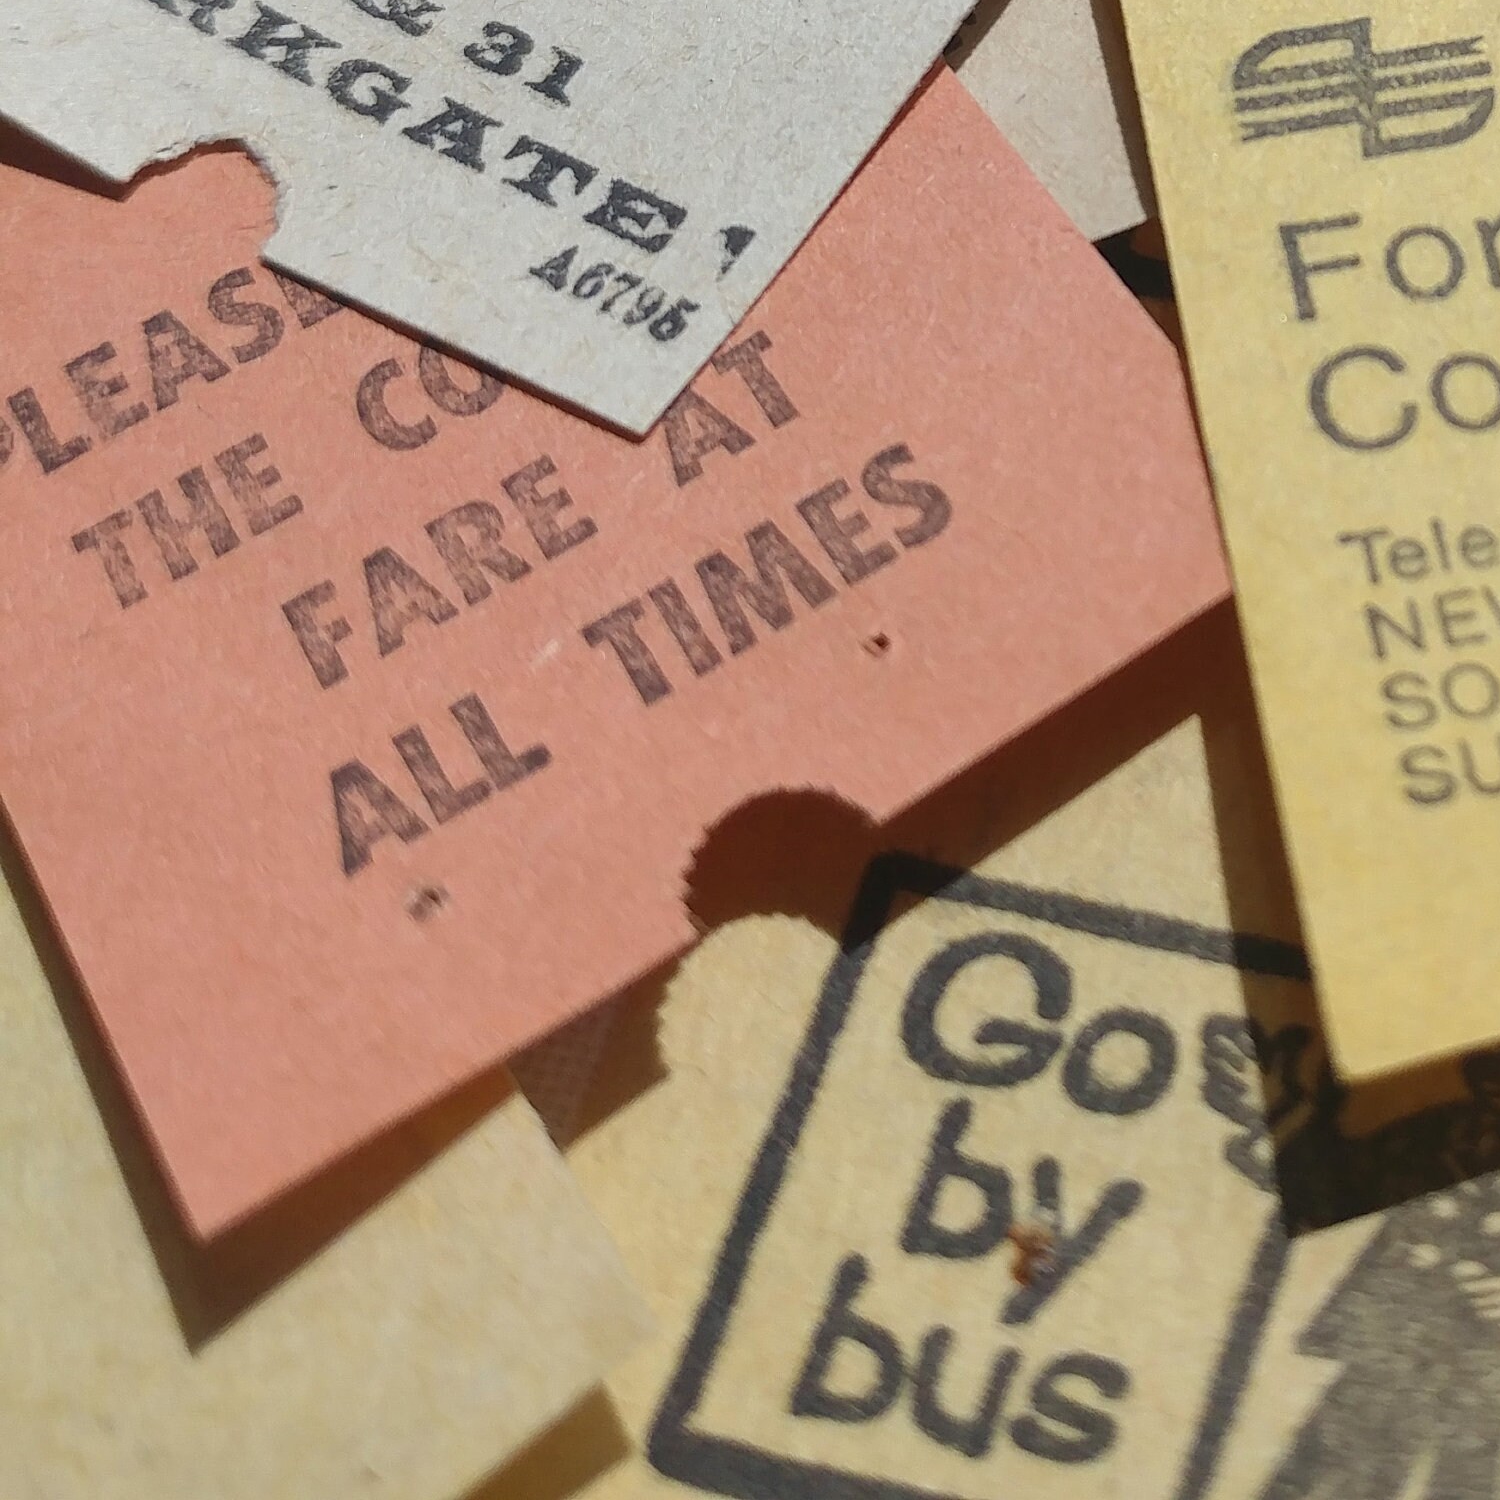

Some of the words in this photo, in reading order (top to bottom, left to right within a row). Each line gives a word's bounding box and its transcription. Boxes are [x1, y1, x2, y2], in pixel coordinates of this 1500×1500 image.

[464, 21, 585, 106] 31
[72, 432, 304, 610] THE
[281, 455, 600, 690] FARE
[662, 330, 800, 488] AT
[328, 693, 552, 877] ALL
[580, 442, 955, 707] TIMES
[901, 929, 1178, 1117] Go
[901, 1097, 1145, 1326] by
[792, 1251, 1131, 1465] bus
